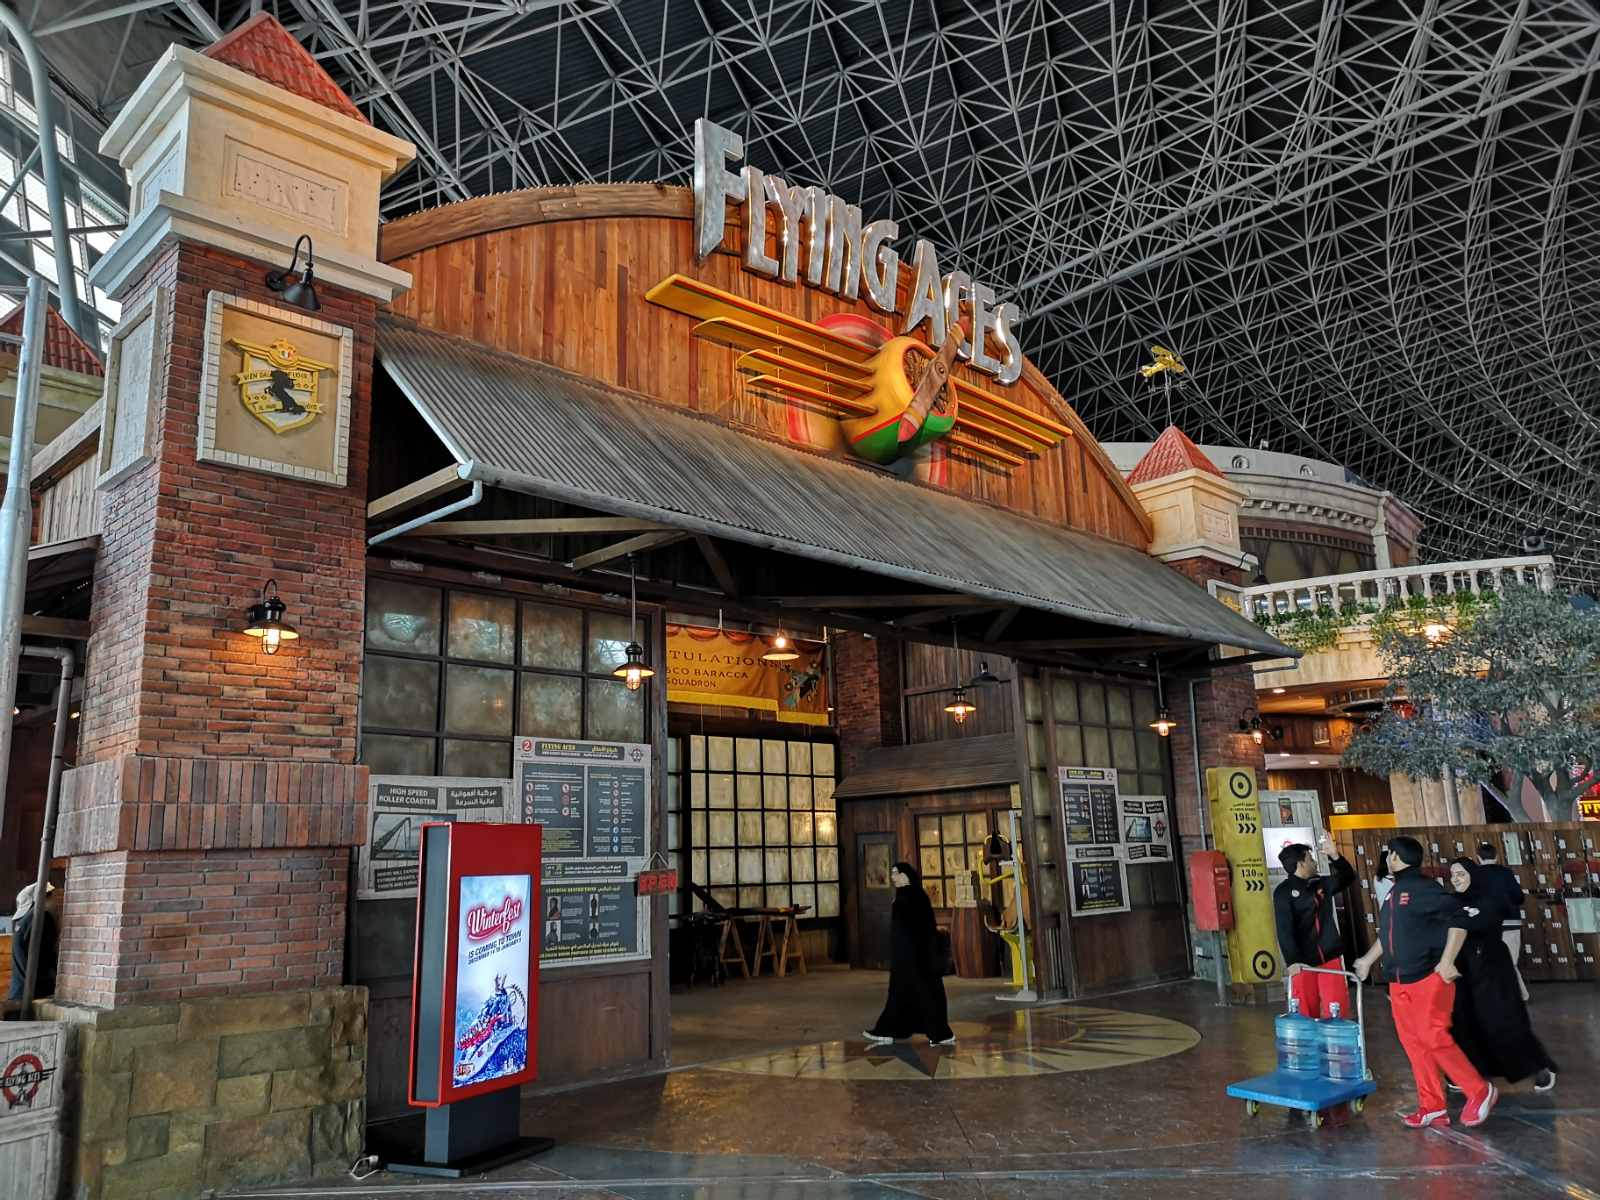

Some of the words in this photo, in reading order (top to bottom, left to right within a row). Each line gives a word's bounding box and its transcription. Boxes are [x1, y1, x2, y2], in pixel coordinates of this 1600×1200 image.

[694, 117, 899, 313] FLYING
[905, 239, 1023, 386] ACES
[378, 795, 405, 804] ROLLER
[405, 796, 436, 805] COASTER
[389, 787, 407, 795] HIGH
[408, 788, 429, 797] SPEED
[467, 896, 522, 934] Winterfest
[468, 950, 475, 959] IS
[474, 940, 498, 956] COMING
[498, 937, 506, 946] TO
[506, 929, 522, 942] TOWN
